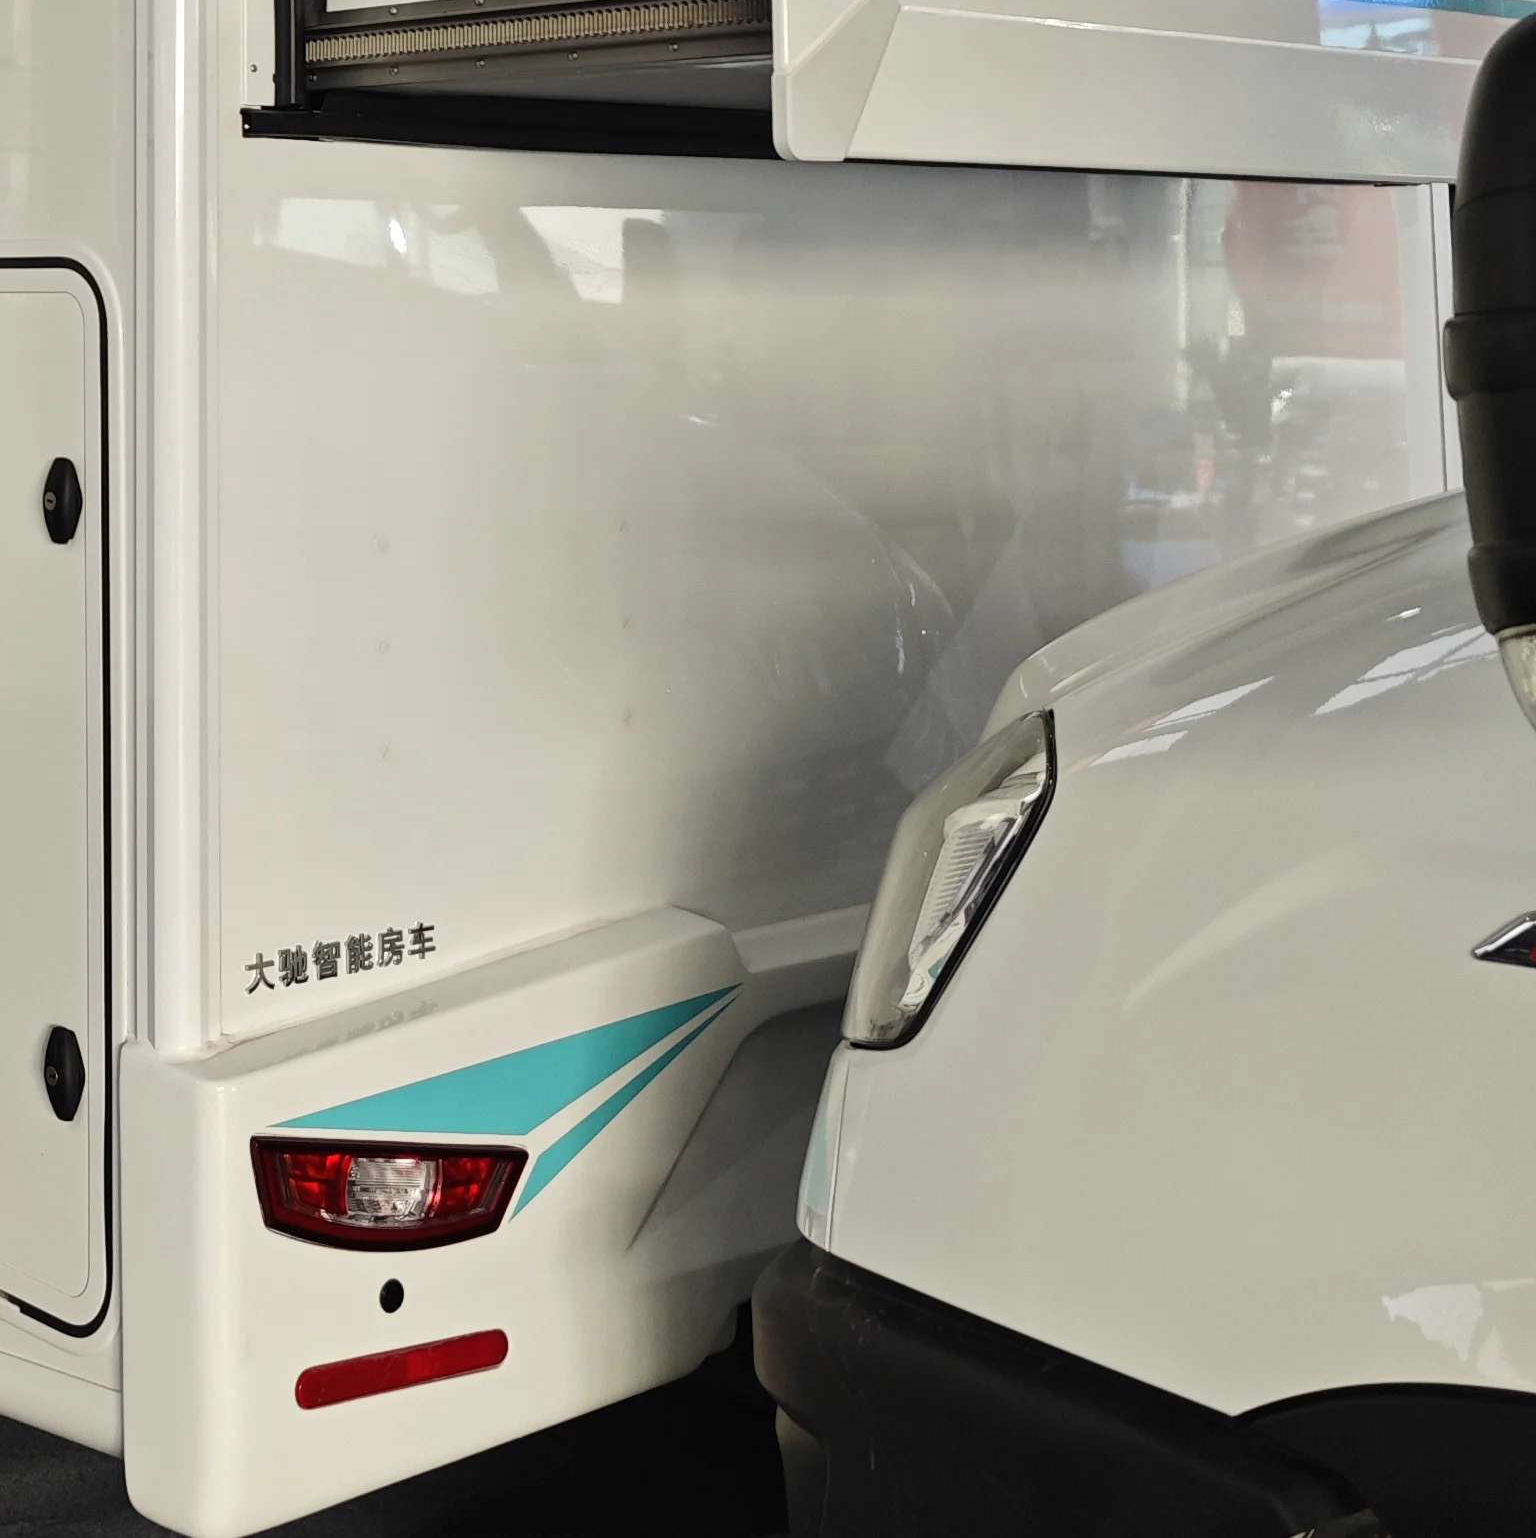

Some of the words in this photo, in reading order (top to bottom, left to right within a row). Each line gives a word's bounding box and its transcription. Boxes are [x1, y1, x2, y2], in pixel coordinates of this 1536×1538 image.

[244, 920, 437, 995] 大驰智能房车
